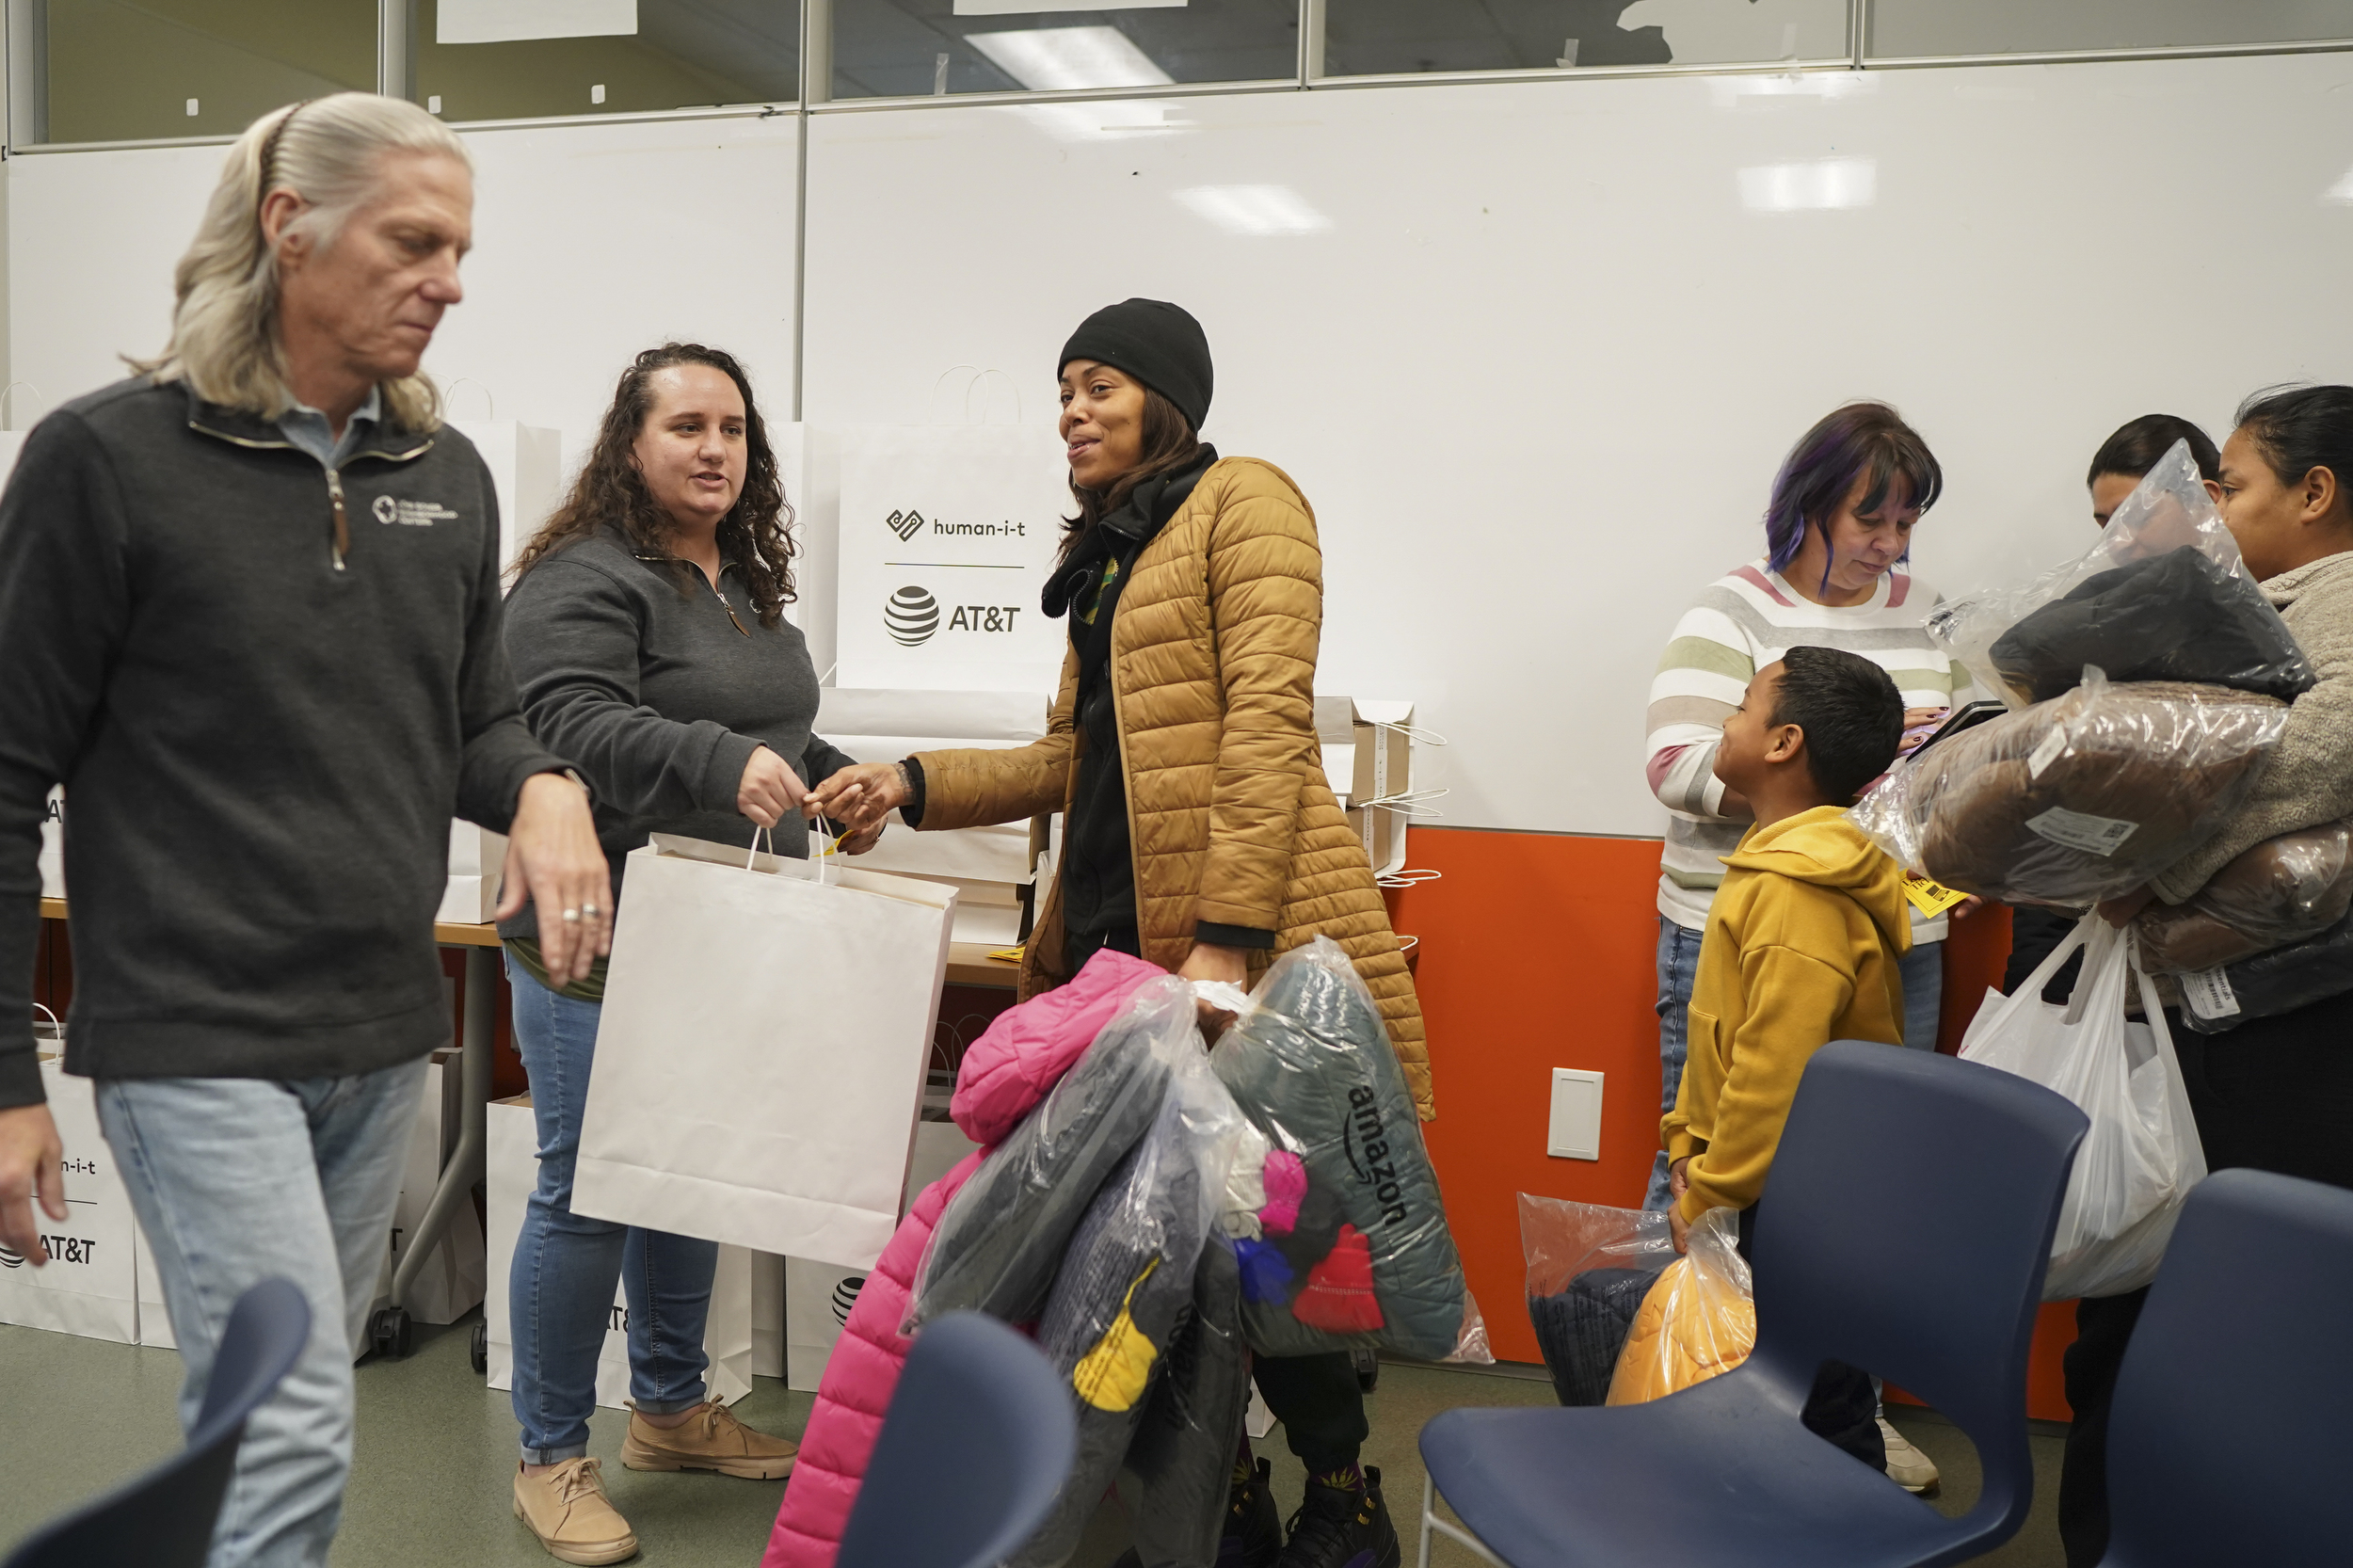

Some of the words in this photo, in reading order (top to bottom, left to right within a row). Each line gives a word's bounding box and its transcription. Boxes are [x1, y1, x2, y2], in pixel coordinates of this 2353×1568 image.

[934, 519, 1026, 536] human-i-t
[948, 605, 1021, 632] AT&T
[2215, 968, 2232, 1001] ssentials
[61, 1158, 96, 1175] n-i-t
[1348, 1085, 1407, 1225] amazon
[40, 1235, 96, 1264] AT&T
